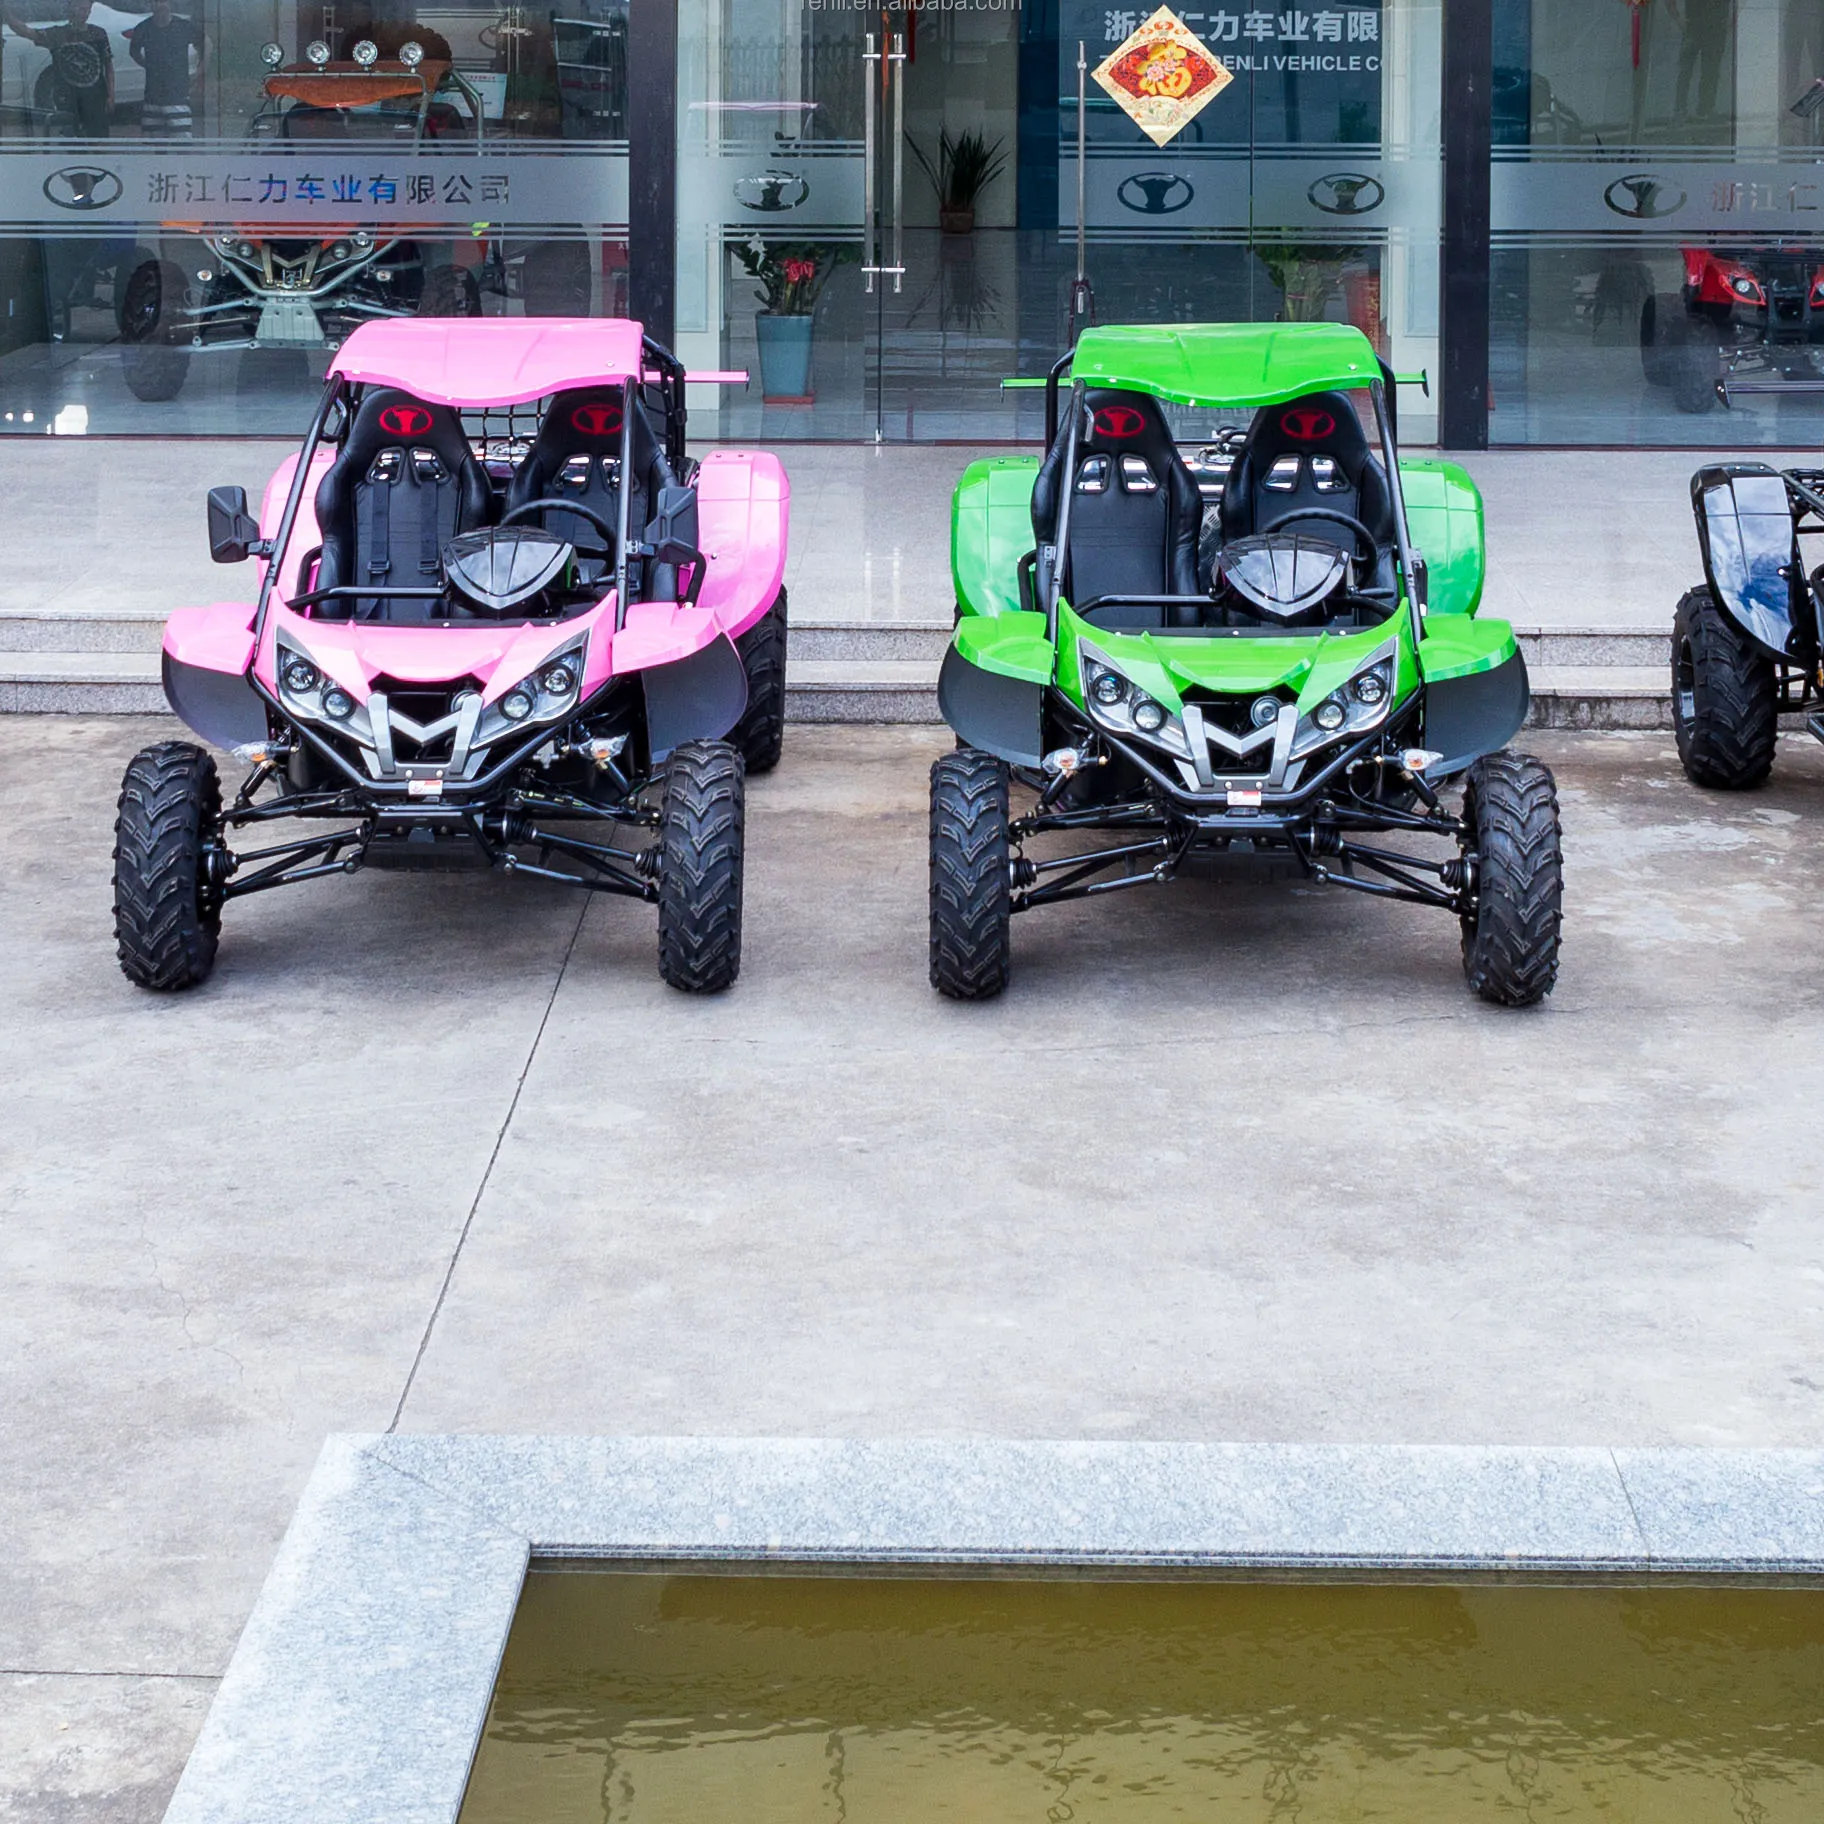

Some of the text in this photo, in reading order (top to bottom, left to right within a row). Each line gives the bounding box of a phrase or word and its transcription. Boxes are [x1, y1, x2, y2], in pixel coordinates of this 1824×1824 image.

[1273, 55, 1362, 72] VEHICLE
[1365, 55, 1383, 72] C
[147, 173, 510, 205] 浙江仁力车业有限公司
